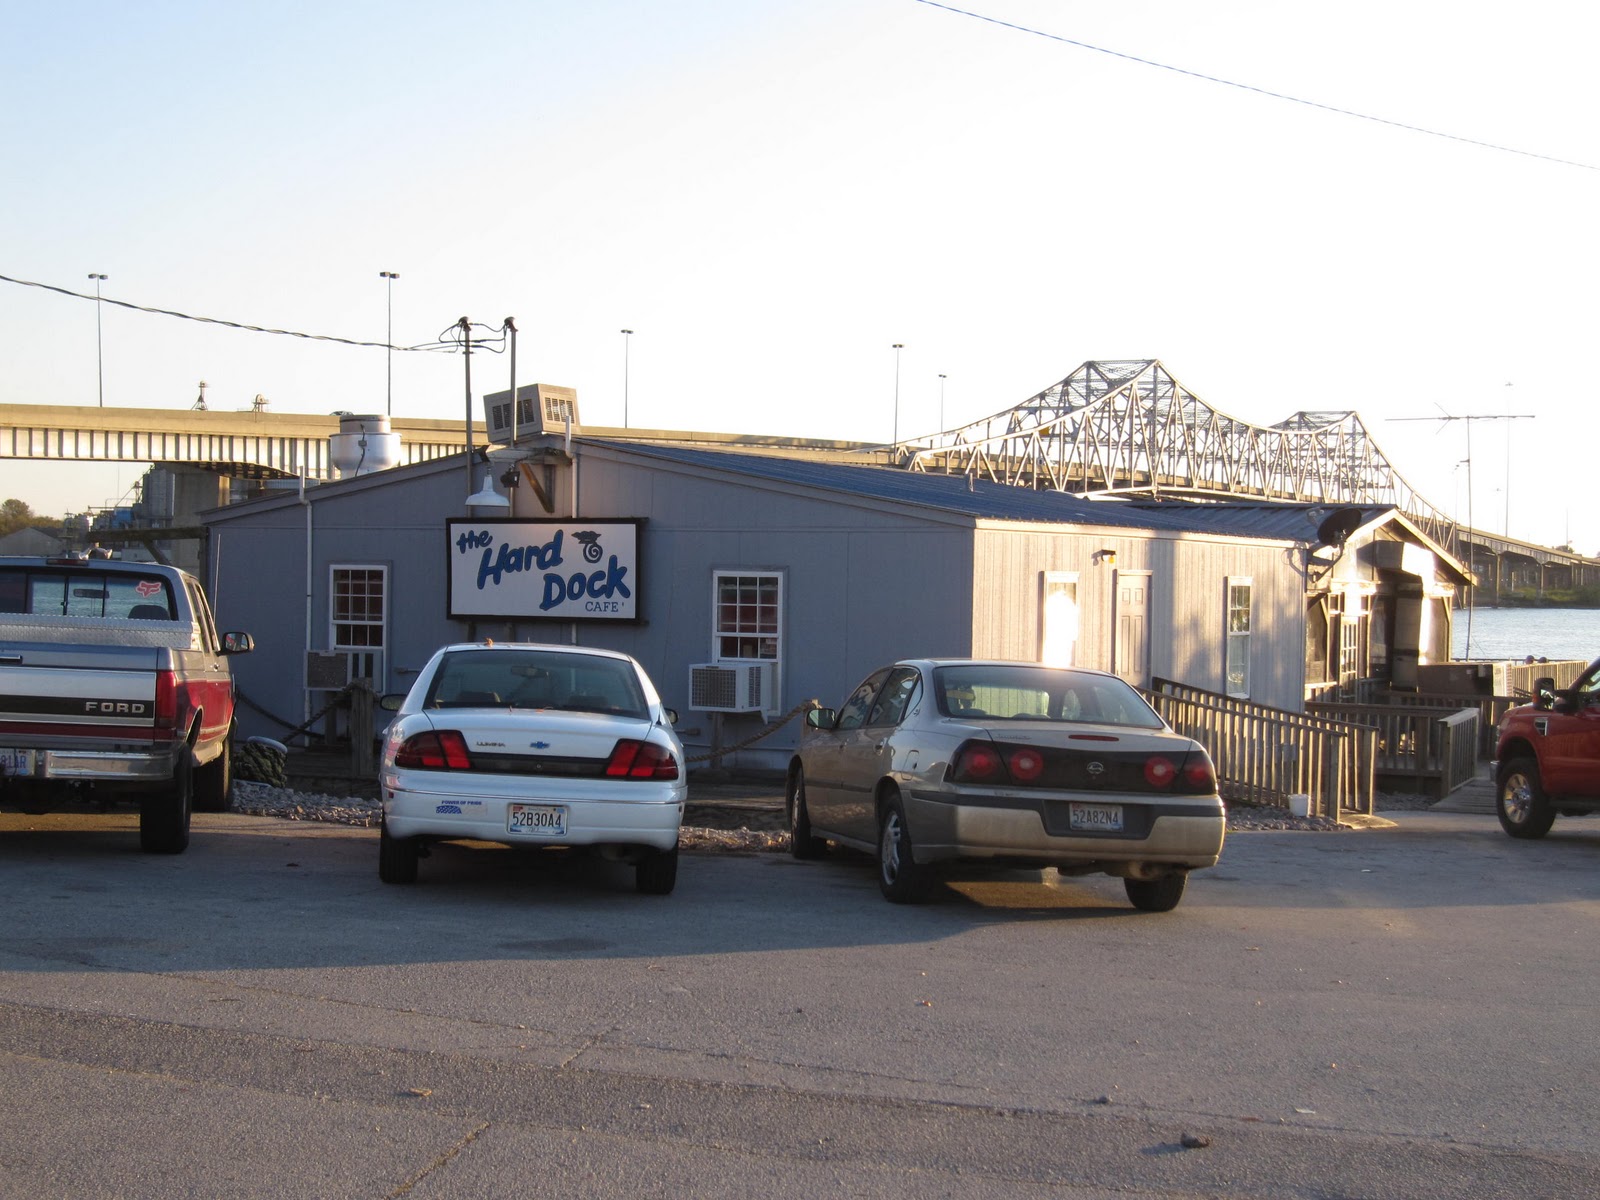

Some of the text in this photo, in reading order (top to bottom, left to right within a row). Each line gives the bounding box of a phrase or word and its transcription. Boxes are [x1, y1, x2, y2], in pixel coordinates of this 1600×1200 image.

[456, 530, 493, 554] the
[477, 529, 564, 590] Hard
[85, 701, 145, 714] FORD
[512, 811, 562, 828] 52B30A4
